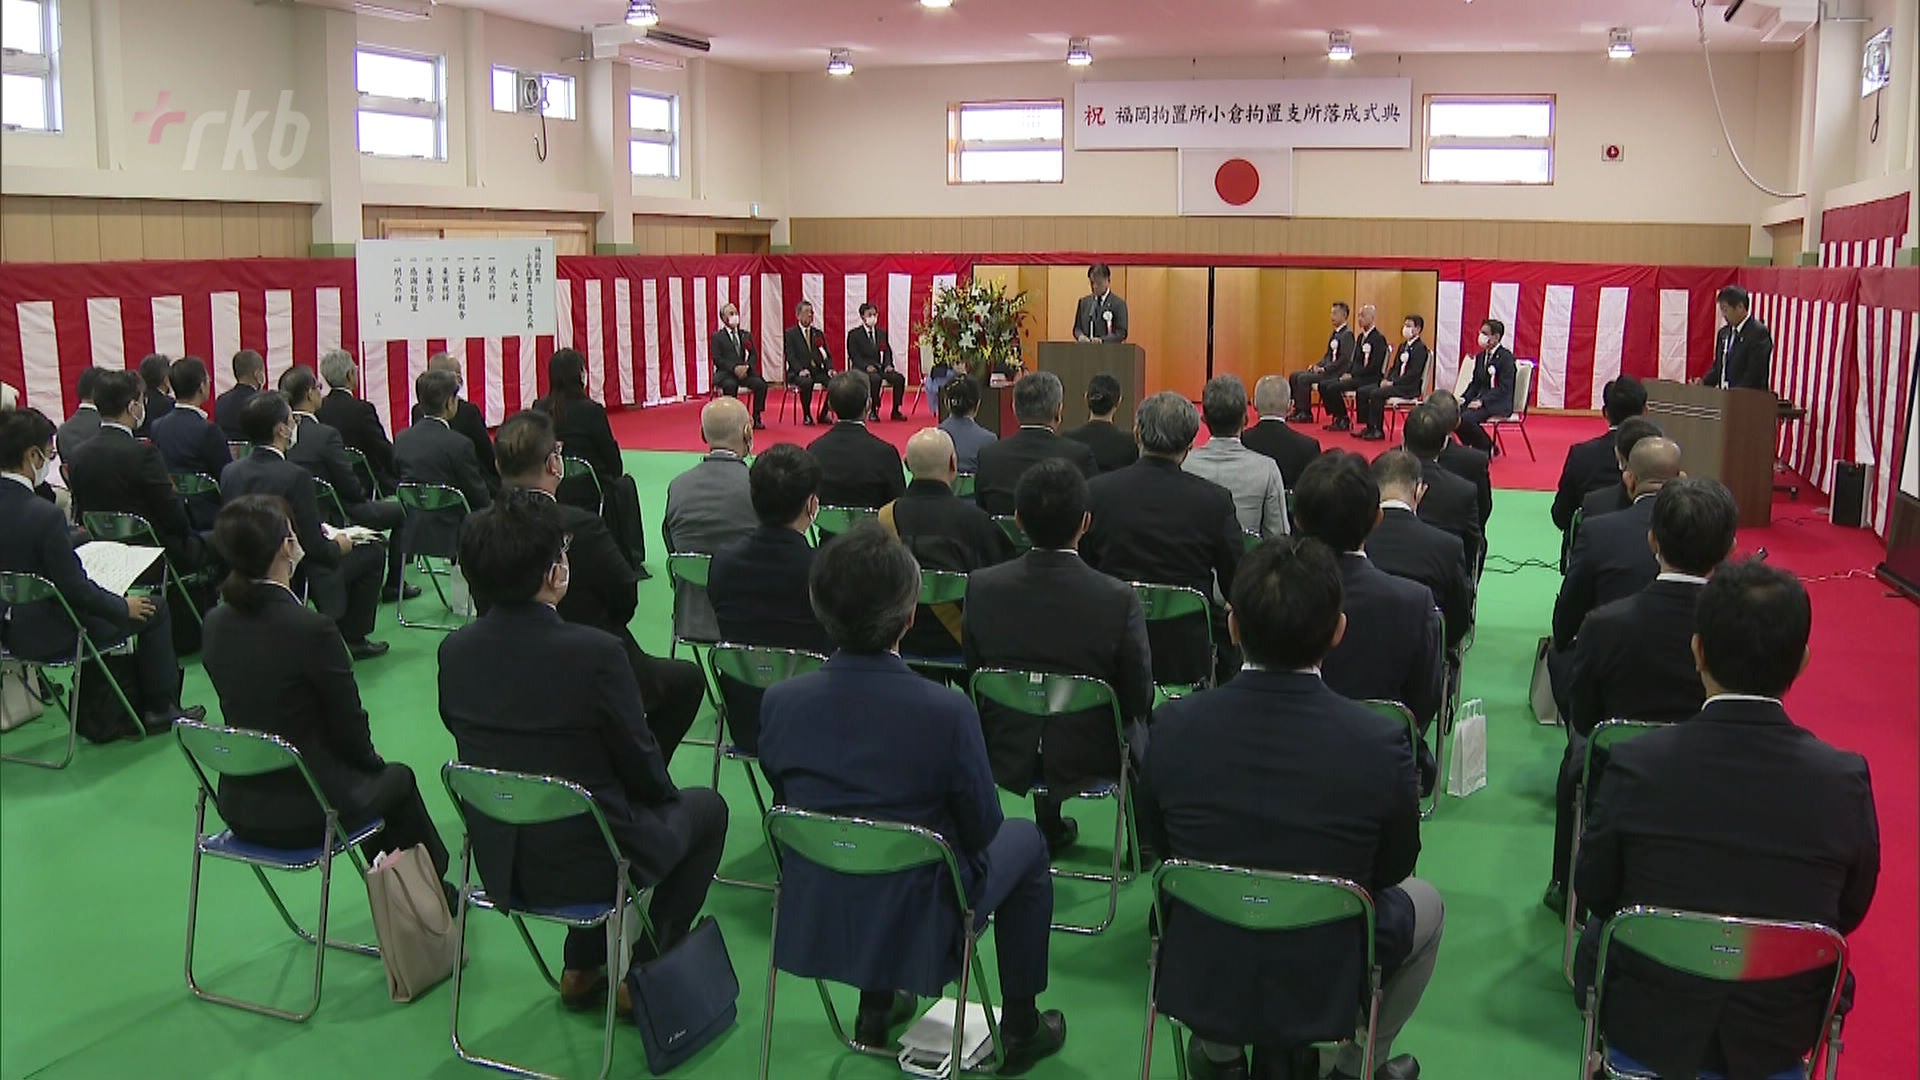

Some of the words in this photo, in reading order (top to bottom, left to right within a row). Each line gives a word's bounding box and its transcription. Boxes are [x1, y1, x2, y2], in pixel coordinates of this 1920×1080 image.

[1084, 105, 1106, 127] 祝
[1114, 103, 1401, 125] 福岡拘置所小倉拘置支所落成式典
